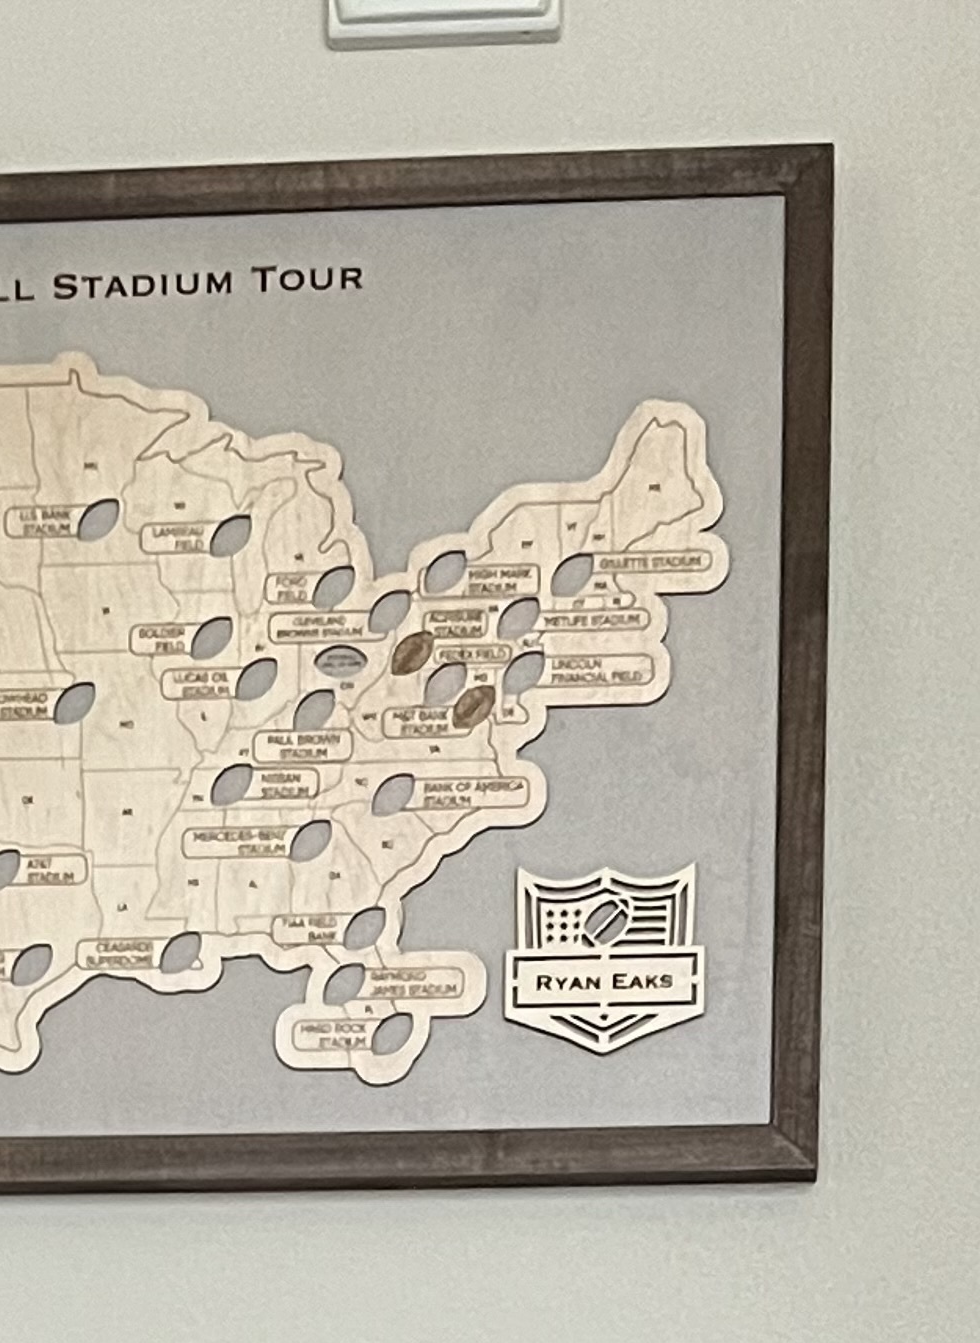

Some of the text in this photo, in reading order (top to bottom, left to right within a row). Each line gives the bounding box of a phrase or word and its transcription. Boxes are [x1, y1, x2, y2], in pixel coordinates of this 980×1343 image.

[53, 270, 232, 300] STADIUM
[251, 265, 363, 293] TOUR
[536, 973, 674, 991] RYAN EAKS
